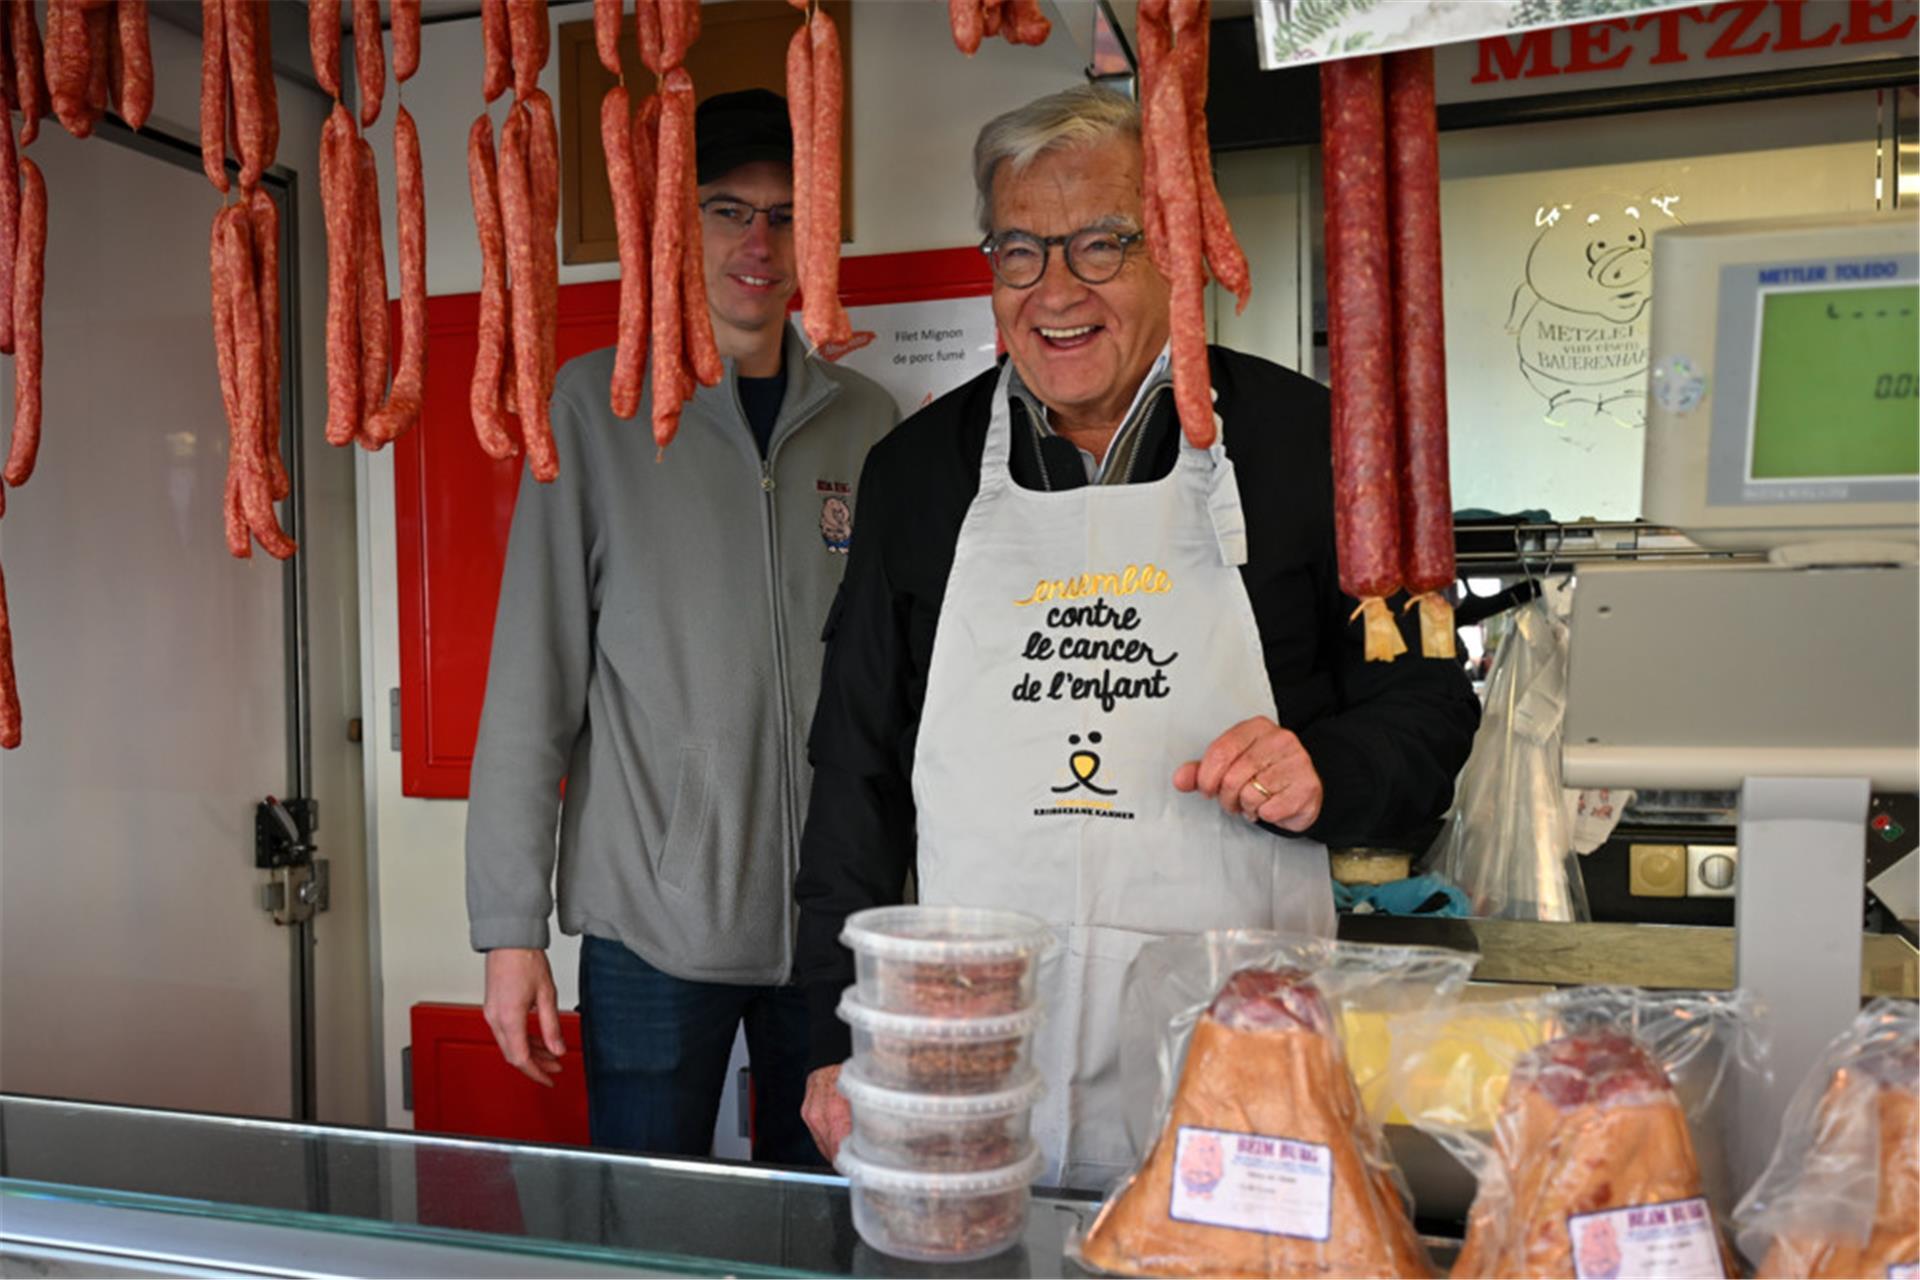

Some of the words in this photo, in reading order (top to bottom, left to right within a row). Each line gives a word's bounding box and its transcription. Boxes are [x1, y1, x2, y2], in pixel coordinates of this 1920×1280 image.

[1758, 266, 1827, 284] METTLER
[1834, 261, 1898, 280] TOLEDO
[895, 330, 918, 342] Filet
[921, 328, 964, 343] Mignon
[893, 354, 907, 365] de
[909, 354, 934, 367] porc
[937, 348, 966, 362] fumé
[1013, 563, 1174, 606] ensemble
[1047, 597, 1141, 630] contre
[1021, 631, 1055, 661] le
[1058, 637, 1178, 666] cancer
[1012, 672, 1042, 702] de
[1047, 668, 1170, 713] l'enfant
